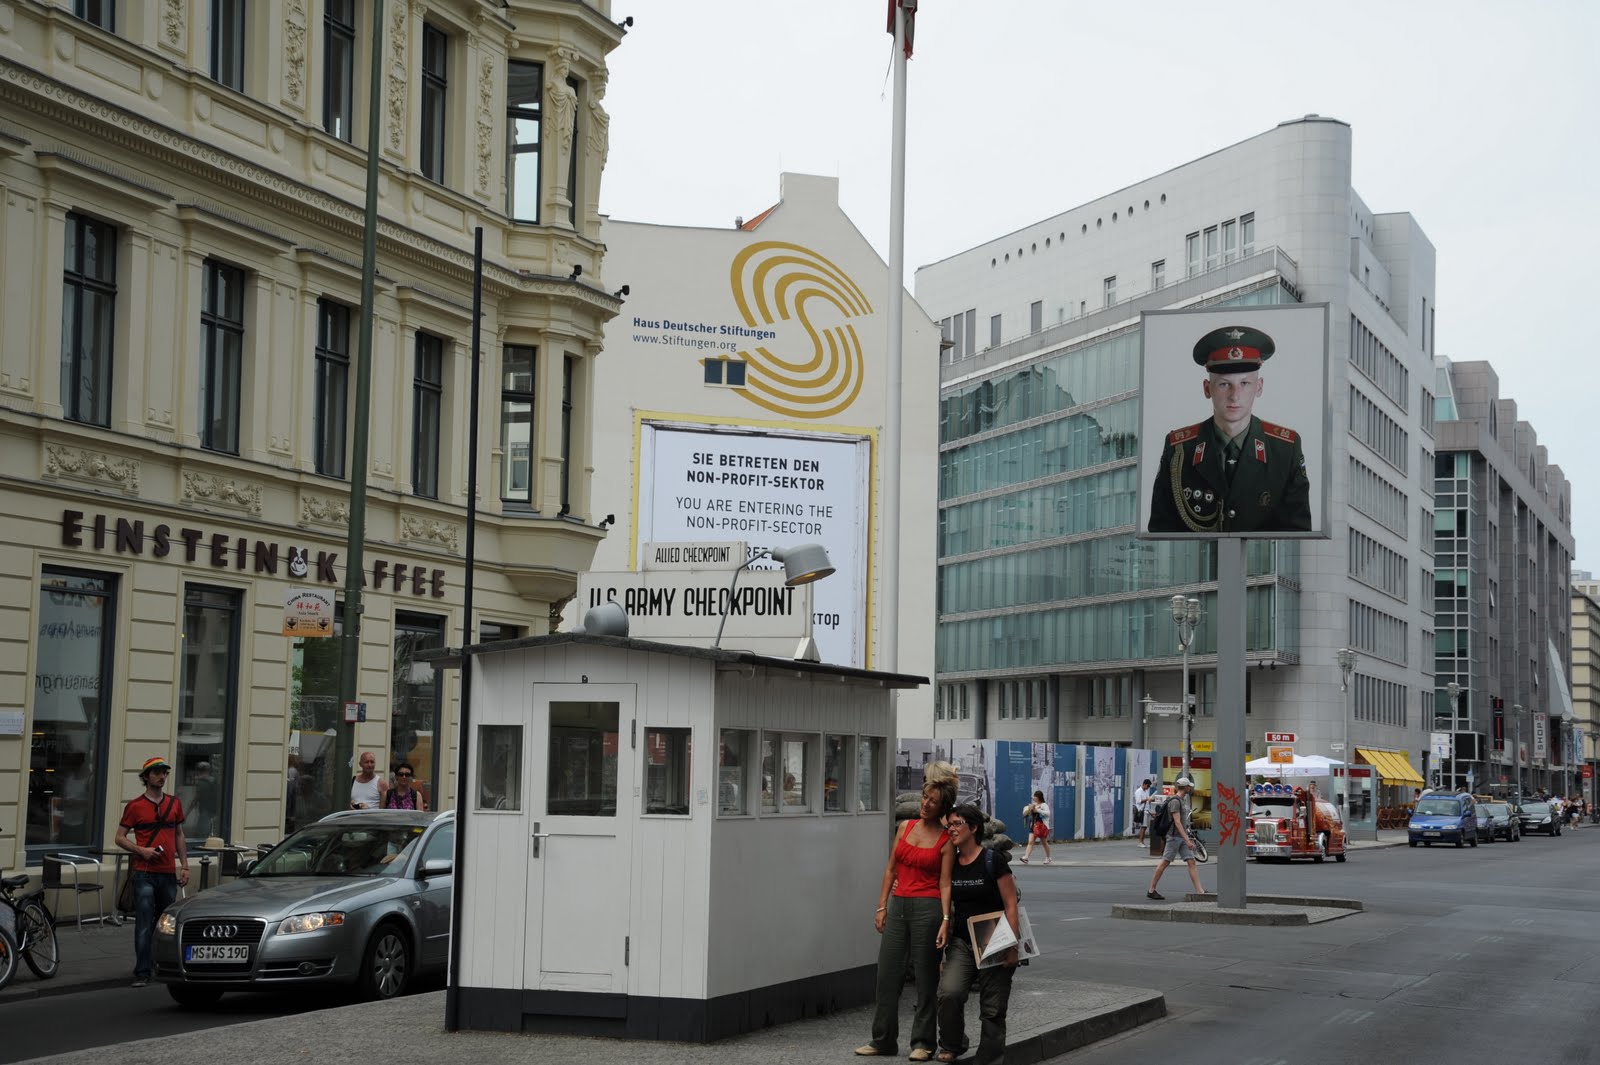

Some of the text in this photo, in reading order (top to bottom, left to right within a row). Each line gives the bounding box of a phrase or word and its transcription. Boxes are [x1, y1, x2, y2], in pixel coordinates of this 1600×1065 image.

[633, 317, 776, 340] Haus Deutscher Stiftungen
[632, 334, 737, 352] www.Stiftungen.org
[692, 452, 820, 472] SIE BETRETEN DEN
[686, 470, 825, 491] NON-PROFIT-SEKTOR
[675, 496, 833, 518] YOU ARE ENTERING THE
[686, 516, 822, 535] NON-PROFIT-SECTOR
[62, 509, 446, 598] EINSTEIN KFFEE
[655, 546, 731, 563] ALLIED CHECKPOINT
[625, 587, 677, 616] ARMY
[683, 587, 796, 616] CHECKPOINT
[1536, 722, 1544, 751] SHOP
[191, 946, 248, 959] MS WS 190
